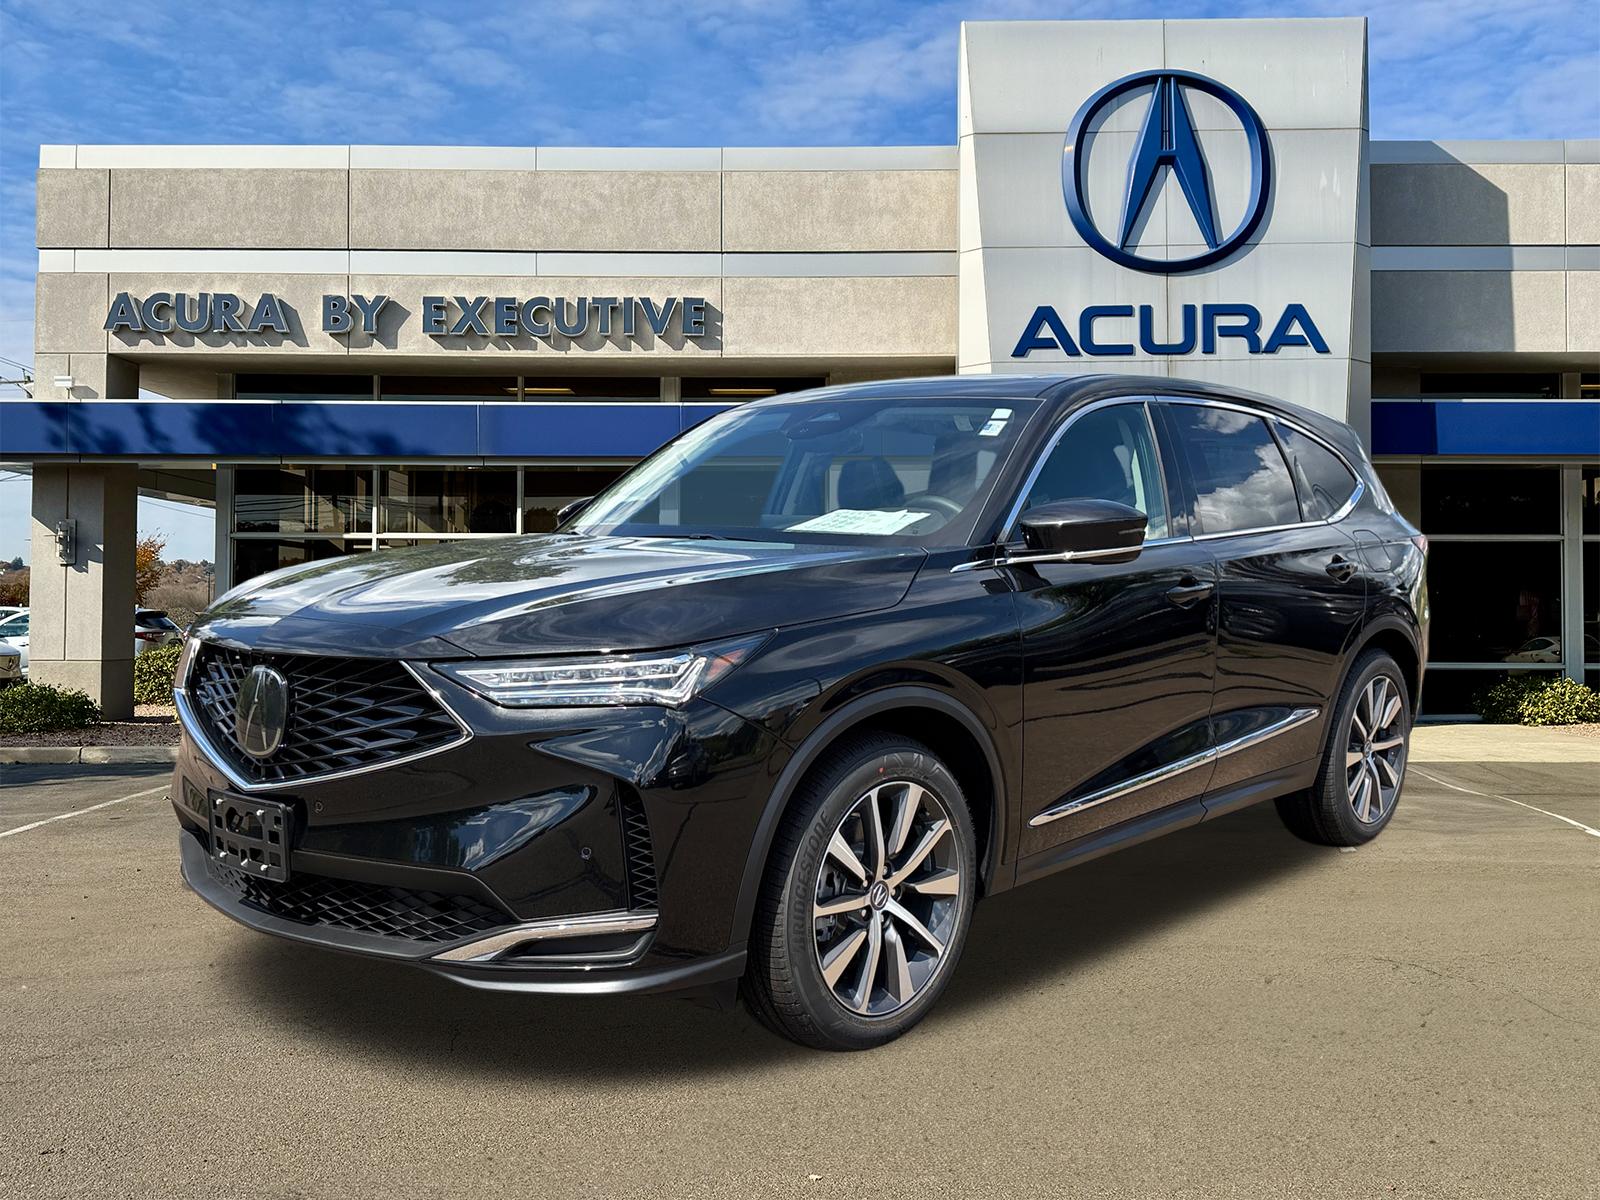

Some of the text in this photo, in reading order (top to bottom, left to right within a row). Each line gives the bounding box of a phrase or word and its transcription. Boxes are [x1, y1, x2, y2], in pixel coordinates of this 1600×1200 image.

[103, 292, 706, 337] ACURA BY EXECUTIVE
[1010, 303, 1331, 357] ACURA
[791, 810, 830, 952] BRIDGESTONE
